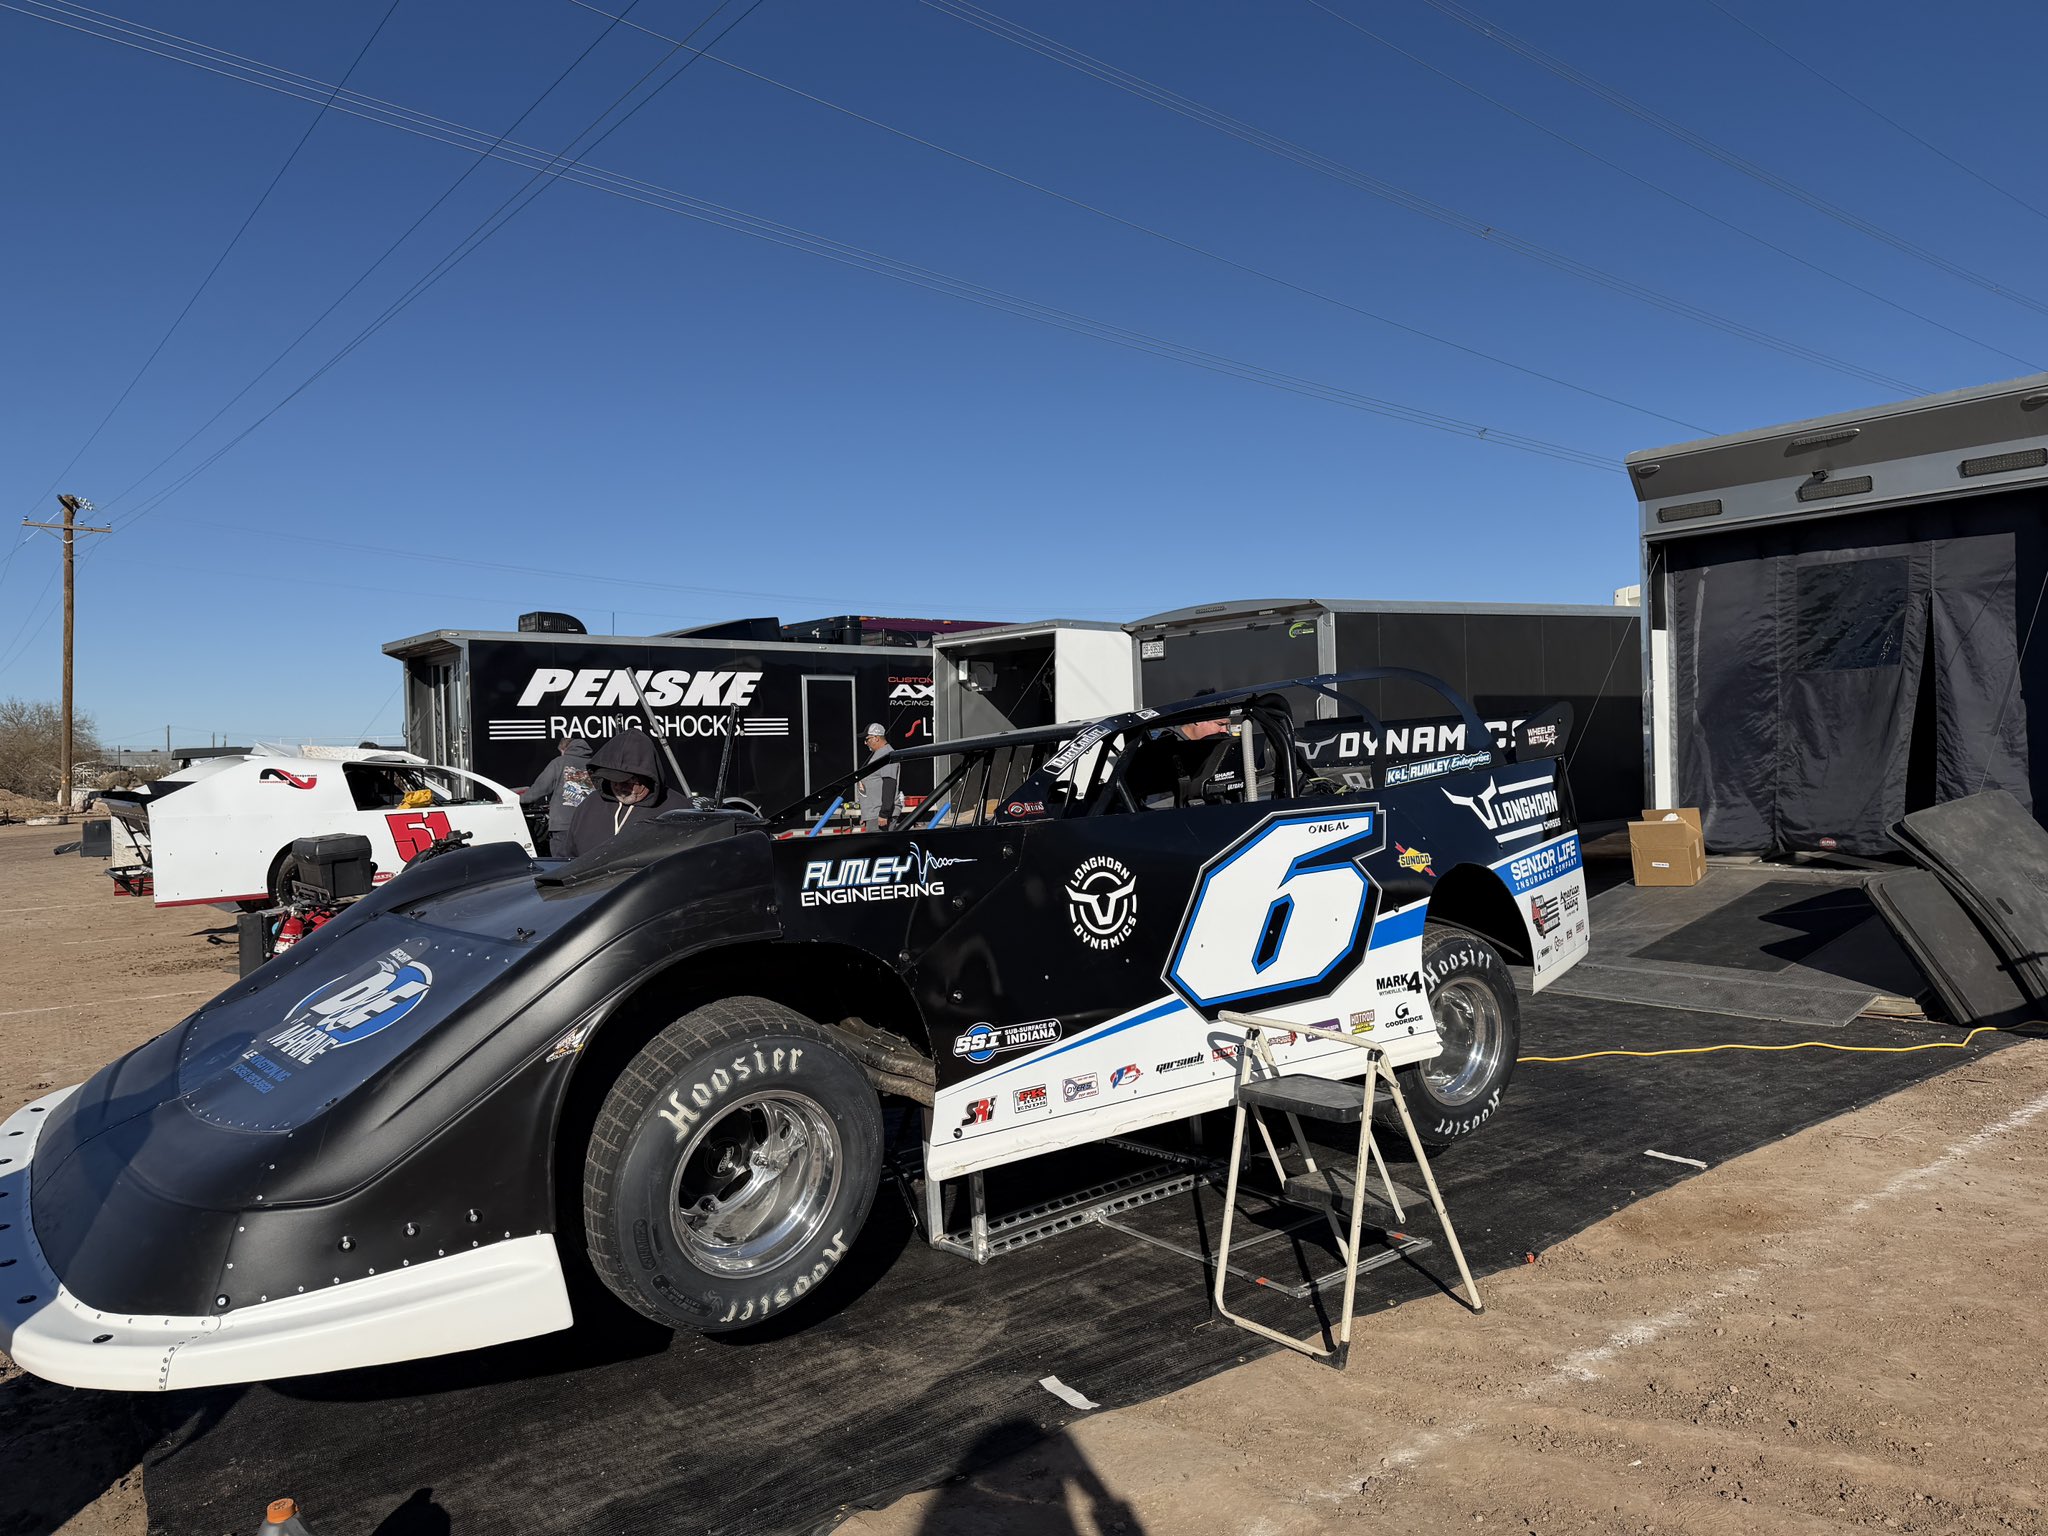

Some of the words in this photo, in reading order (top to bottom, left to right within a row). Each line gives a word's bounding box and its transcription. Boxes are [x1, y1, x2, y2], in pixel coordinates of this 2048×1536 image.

[517, 668, 763, 706] PENSKE
[551, 715, 641, 738] RACING
[650, 715, 741, 737] SHOCKS
[1339, 720, 1526, 757] DYNAMC
[1527, 725, 1555, 736] WHEELER
[1528, 734, 1548, 745] METALS
[1387, 771, 1407, 783] K&L
[1410, 760, 1449, 778] RUMLEY
[1494, 790, 1559, 826] LONGHORN
[1544, 817, 1561, 830] CHASSIS
[1308, 822, 1350, 834] O'NEAL
[802, 856, 914, 890] RUMLEY
[1070, 856, 1130, 887] LONGHORN
[1400, 853, 1430, 866] SUNOCO
[1510, 848, 1556, 880] SENIOR
[1556, 840, 1577, 860] LIFE
[1515, 867, 1554, 890] INSURANCE
[1555, 858, 1577, 874] COMPANY
[801, 882, 945, 907] ENGINEERING
[1170, 811, 1374, 1008] 6
[1073, 916, 1137, 950] DYNAMICS
[1424, 942, 1493, 994] Hoosier
[1004, 1023, 1047, 1036] SUB-SURFACE
[1006, 1027, 1056, 1044] INDIANA
[1385, 1015, 1423, 1028] GOODRIDGE
[267, 1024, 340, 1065] MARINE
[955, 1031, 1002, 1054] SSI
[658, 1043, 803, 1143] Hoosier
[1435, 1088, 1500, 1136] Hoosier
[720, 1228, 849, 1323] Hoosier
